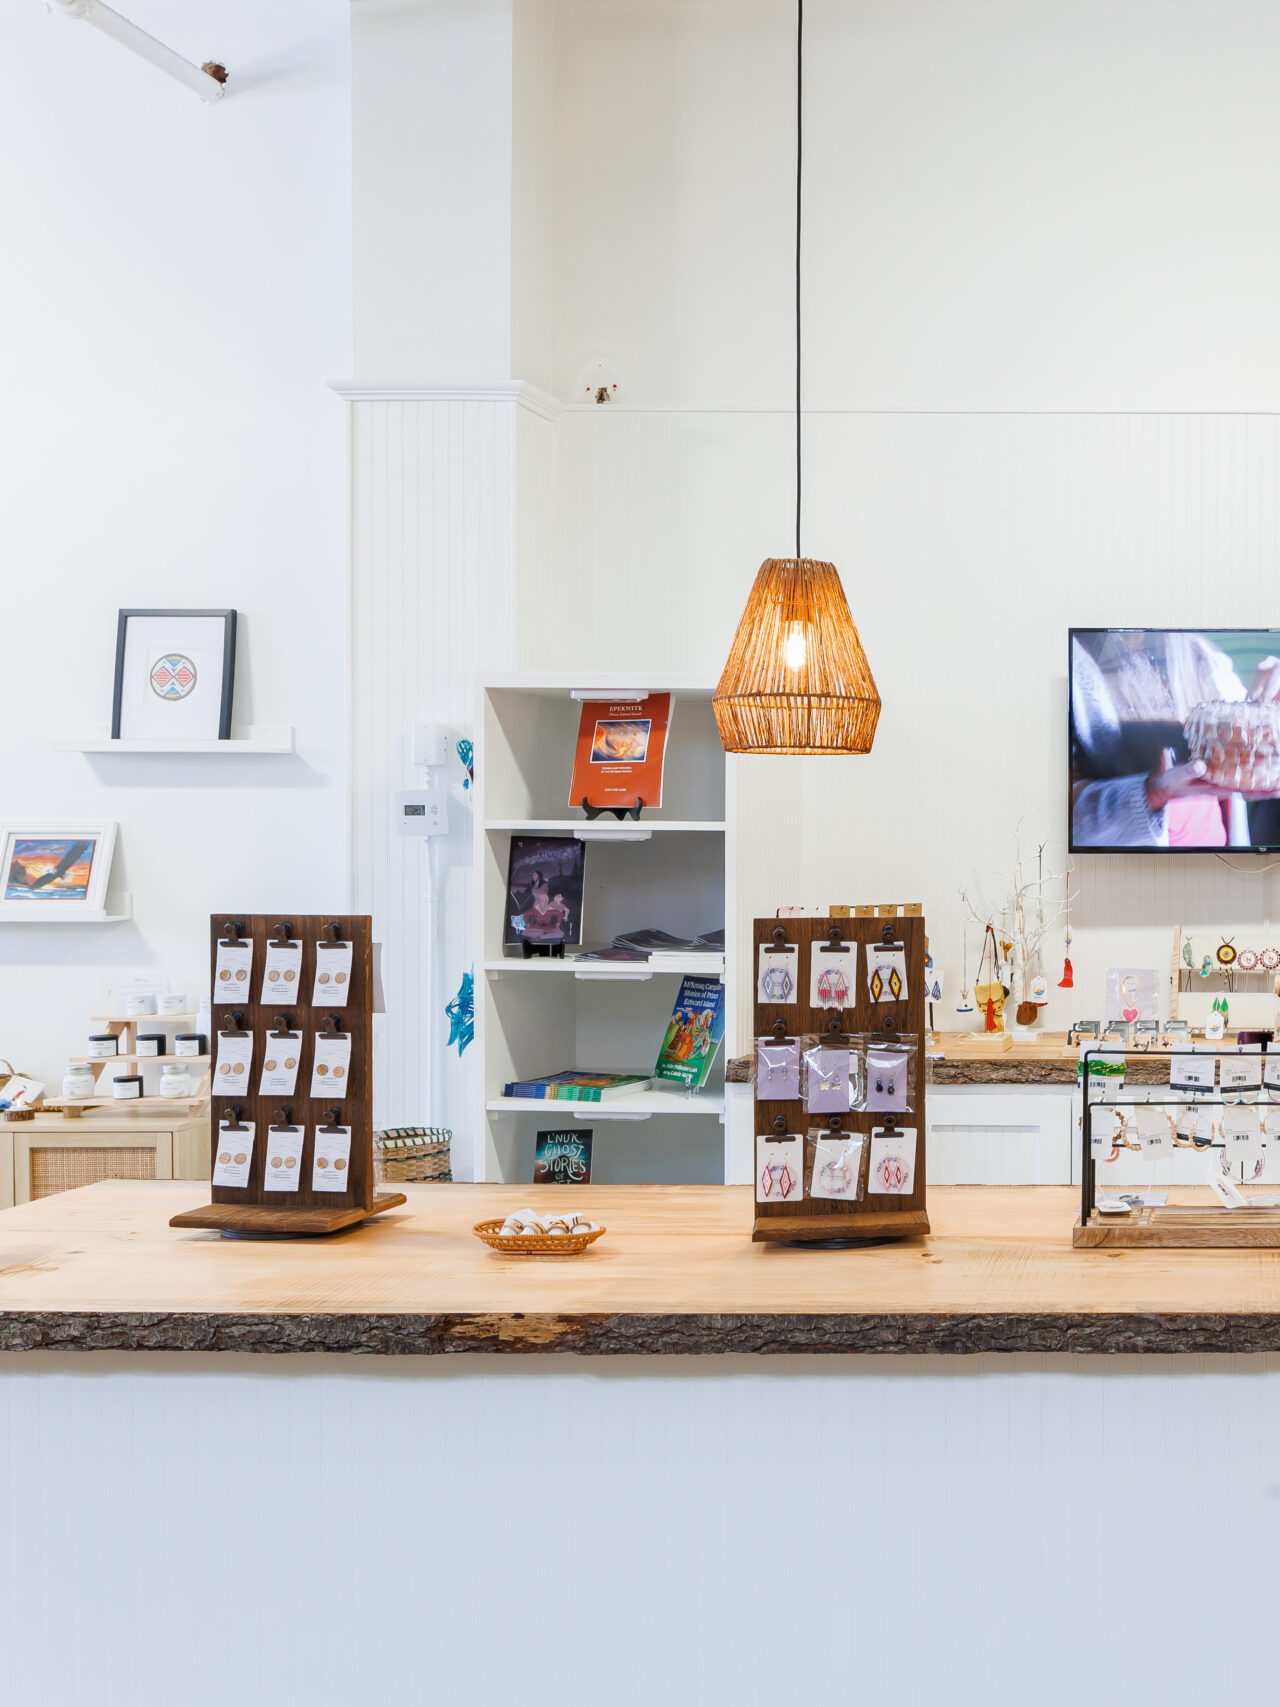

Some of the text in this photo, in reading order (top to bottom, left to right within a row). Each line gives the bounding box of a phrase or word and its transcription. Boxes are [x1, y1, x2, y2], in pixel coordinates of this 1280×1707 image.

[683, 998, 702, 1007] Edward
[545, 1144, 584, 1160] GHOST
[540, 1157, 586, 1180] STORIES
